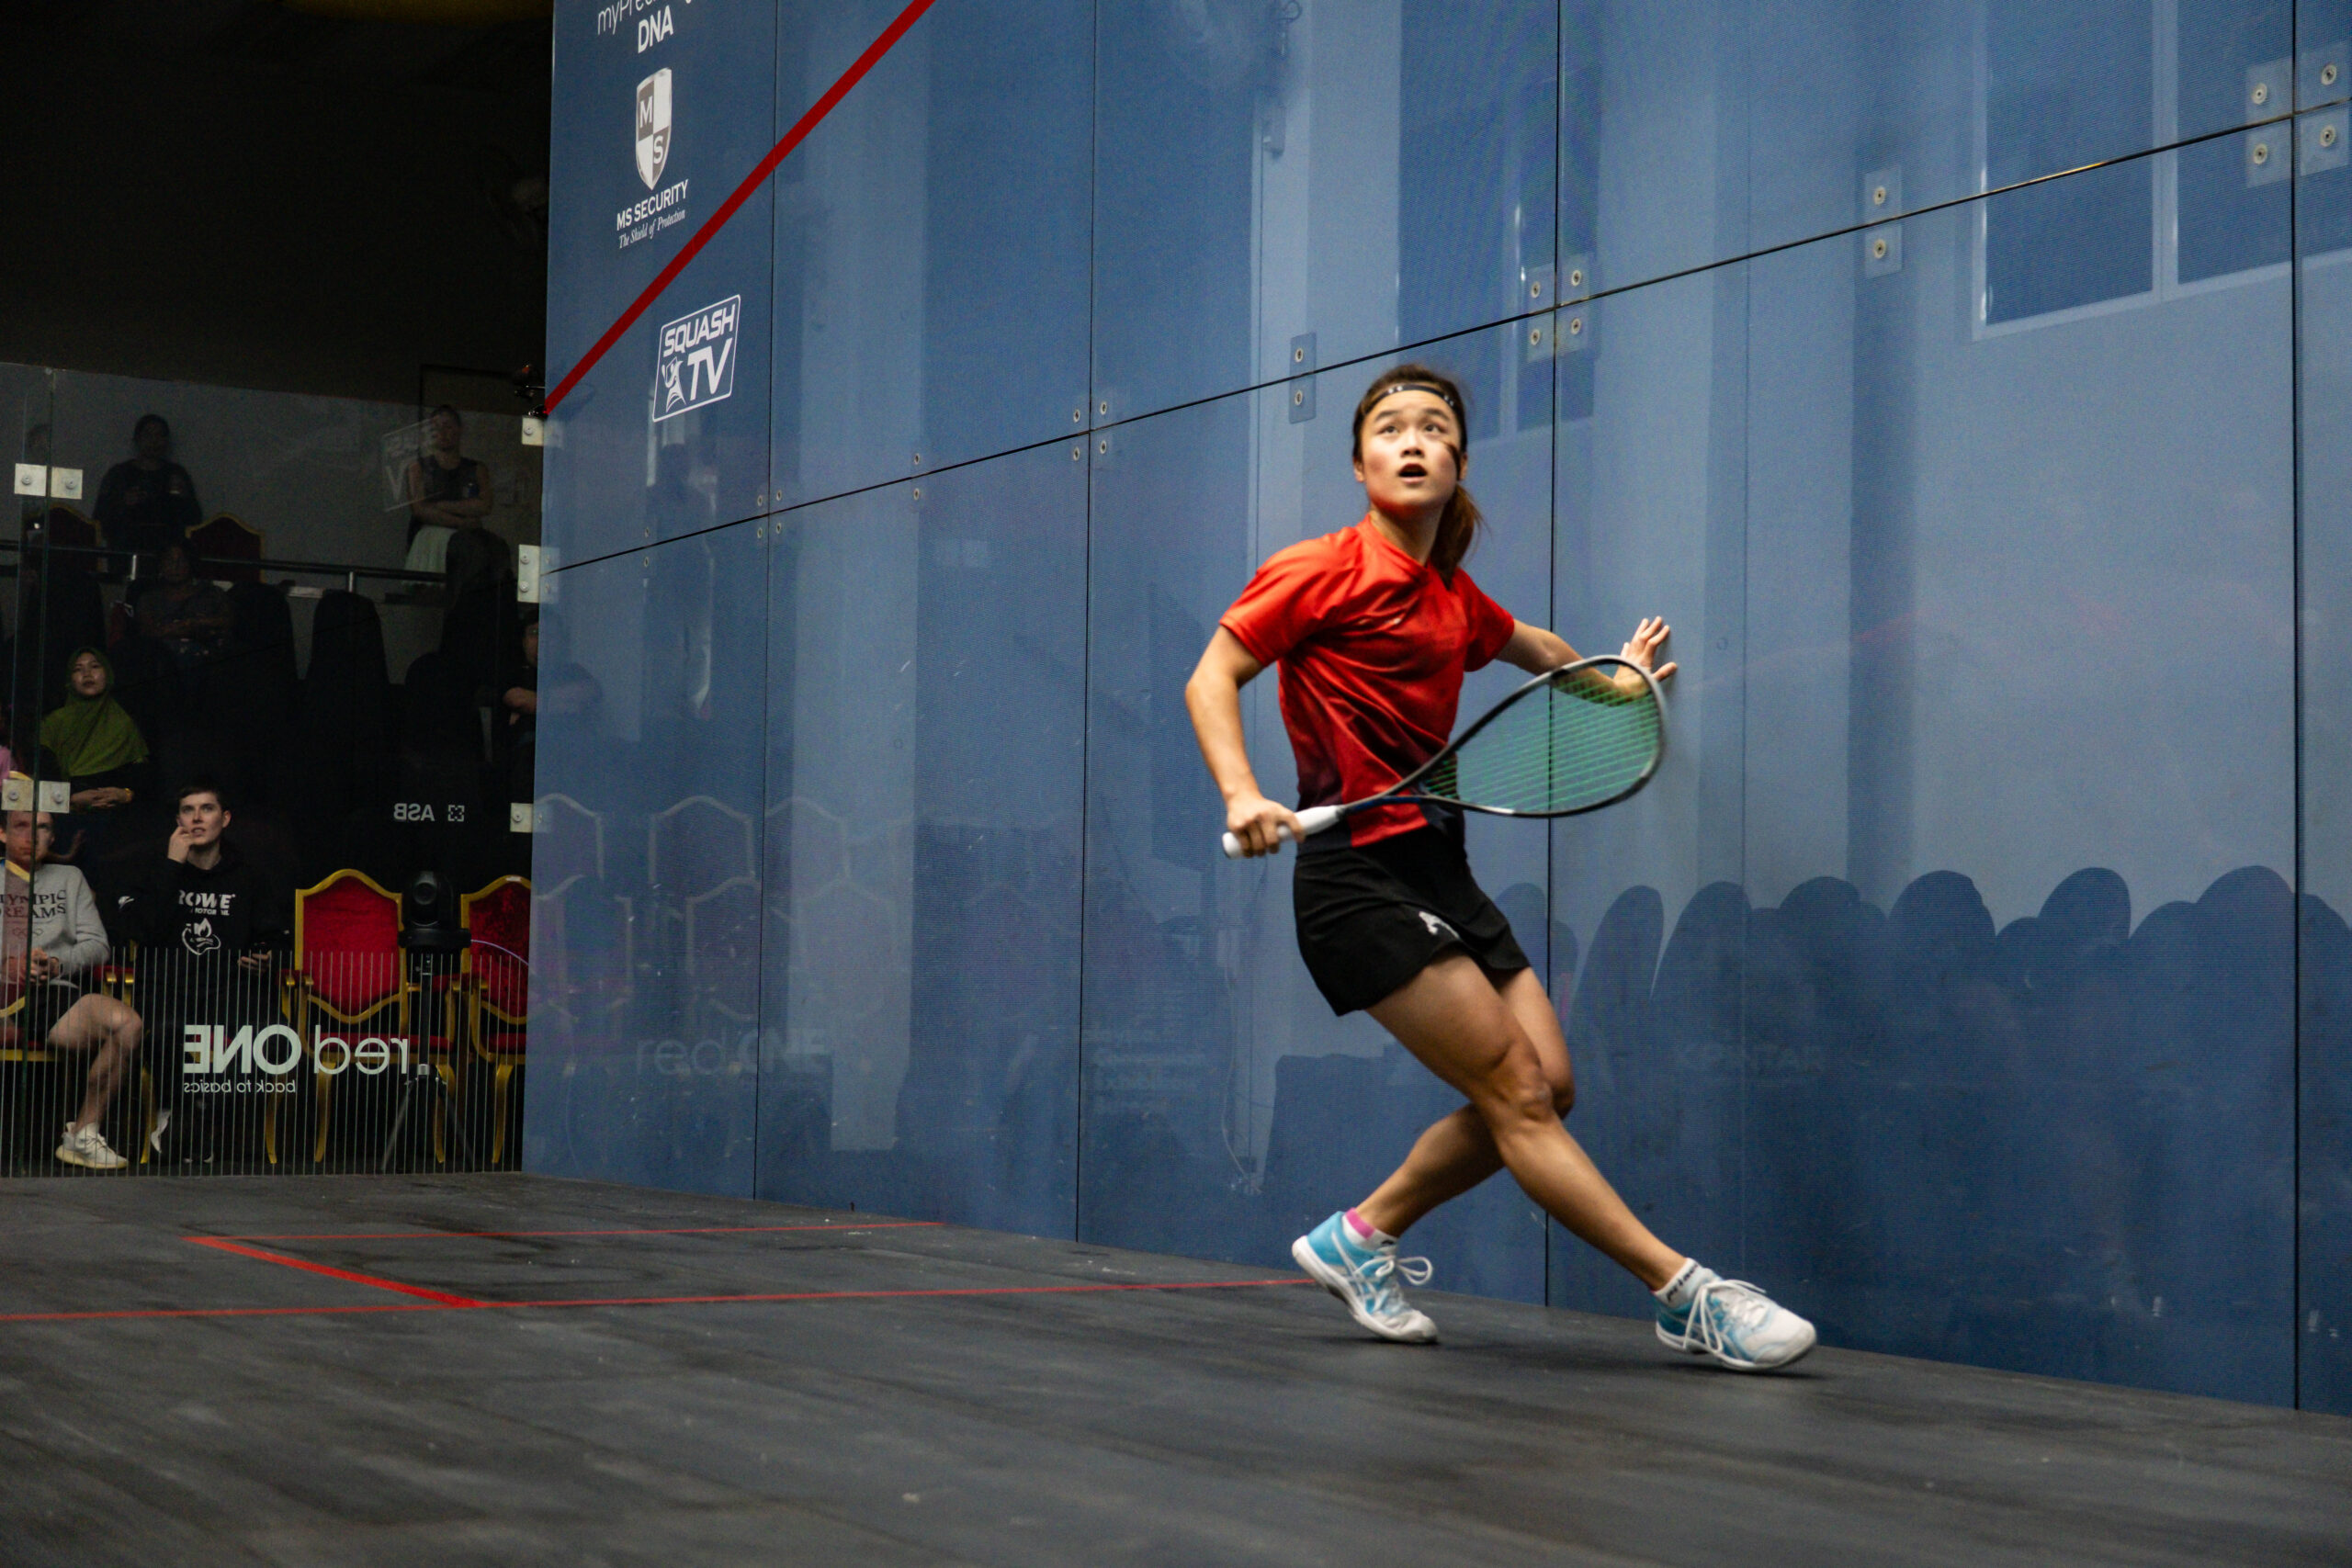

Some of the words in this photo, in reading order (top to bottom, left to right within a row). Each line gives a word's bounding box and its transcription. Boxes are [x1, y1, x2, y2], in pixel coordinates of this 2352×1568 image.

[638, 5, 673, 54] DNA
[639, 96, 653, 129] M
[653, 135, 664, 164] S
[616, 208, 632, 231] MS
[634, 179, 689, 222] SECURITY
[619, 232, 630, 249] The
[630, 222, 648, 243] Shield
[649, 218, 657, 240] of
[657, 207, 685, 231] Protection
[663, 303, 736, 358] SQUASH
[687, 337, 733, 401] TV
